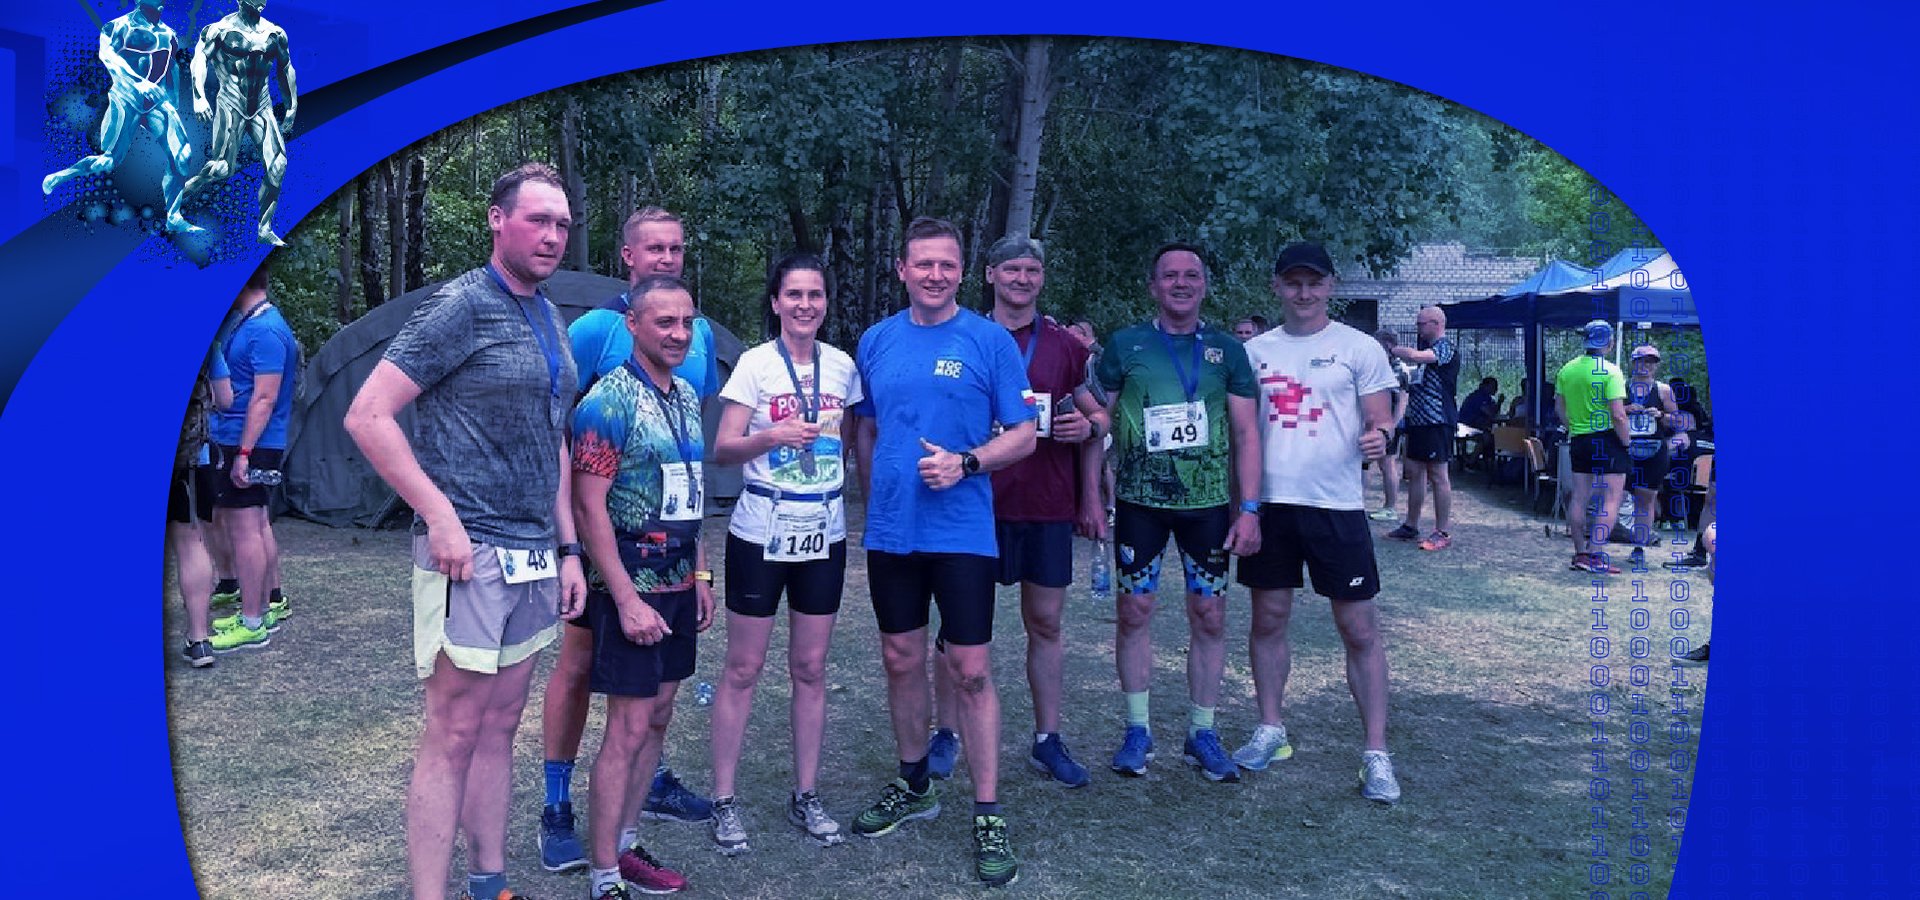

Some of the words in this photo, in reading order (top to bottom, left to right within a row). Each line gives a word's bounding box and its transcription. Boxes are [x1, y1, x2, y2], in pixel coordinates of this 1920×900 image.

[1171, 423, 1197, 443] 49
[786, 533, 824, 555] 140
[527, 549, 547, 571] 48
